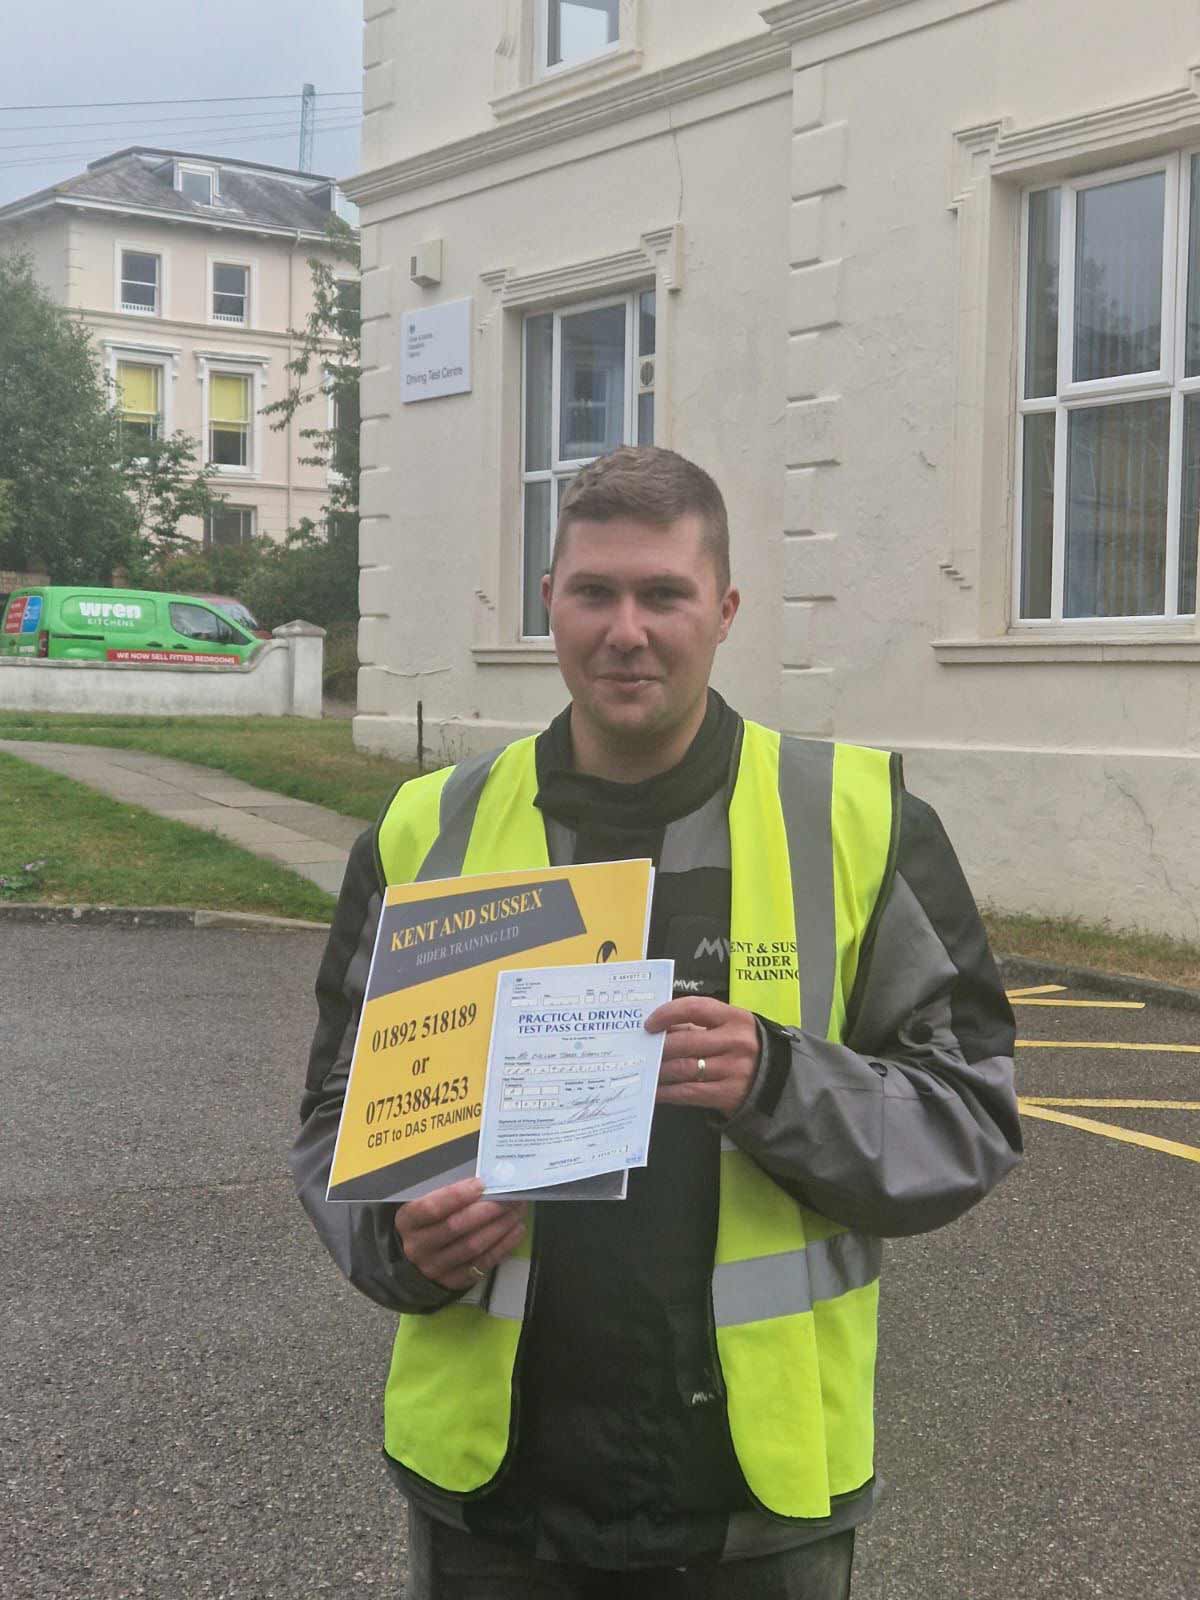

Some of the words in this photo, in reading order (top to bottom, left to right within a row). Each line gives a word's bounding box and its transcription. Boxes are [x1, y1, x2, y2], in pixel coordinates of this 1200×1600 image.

[406, 373, 427, 385] Driving
[428, 369, 441, 381] Test
[442, 366, 463, 379] Centre
[79, 602, 141, 619] wren
[131, 652, 150, 660] NOW
[151, 653, 168, 661] SELL
[169, 653, 194, 662] FITTED
[195, 655, 235, 664] BEDROOMS
[391, 919, 438, 952] KENT
[440, 908, 476, 936] AND
[479, 888, 543, 924] SUSSEX
[416, 945, 447, 966] RIDER
[450, 932, 498, 956] TRAINING
[499, 926, 520, 943] LTD
[756, 942, 769, 954] &
[746, 955, 791, 967] RIDER
[518, 1012, 584, 1024] PRACTICAL
[588, 1008, 643, 1021] DRIVING
[372, 1019, 417, 1053] 01892
[421, 1002, 478, 1038] 518189
[519, 1024, 543, 1034] TEST
[546, 1023, 571, 1033] PASS
[574, 1021, 642, 1032] CERTIFICATE
[412, 1056, 430, 1076] or
[366, 1076, 469, 1126] 07733884253
[367, 1129, 390, 1149] CBT
[392, 1128, 402, 1143] to
[405, 1118, 427, 1139] DAS
[430, 1103, 482, 1130] TRAINING
